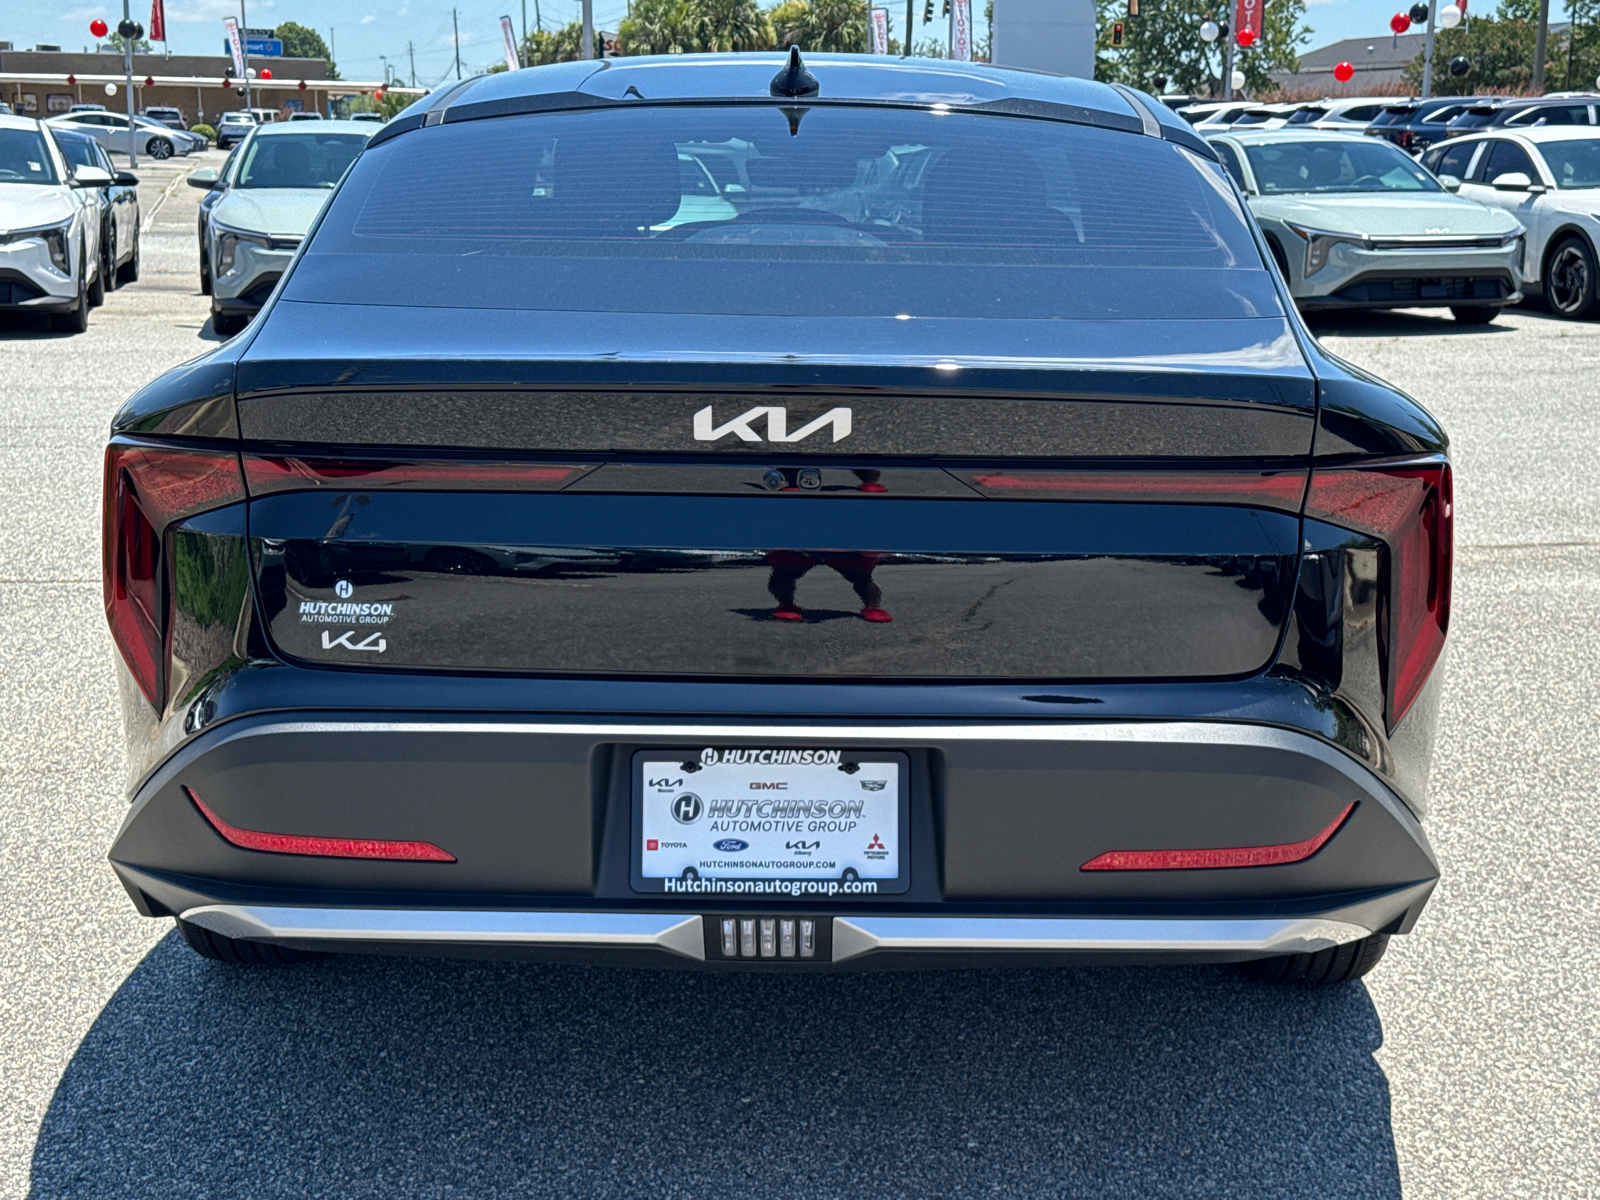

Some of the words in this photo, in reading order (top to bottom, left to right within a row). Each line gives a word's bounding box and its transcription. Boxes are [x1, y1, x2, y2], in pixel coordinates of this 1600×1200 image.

[694, 405, 852, 443] KIA
[299, 602, 393, 615] HUTCHINSON
[301, 615, 356, 623] AUTOMOTIVE
[359, 616, 389, 624] GROUP
[321, 630, 387, 653] K4
[722, 749, 841, 764] HUTCHINSON
[649, 778, 683, 787] KIA
[707, 800, 864, 819] HUTCHINSON
[710, 820, 804, 832] AUTOMOTIVE
[807, 820, 857, 832] GROUP
[719, 840, 743, 850] Ford
[785, 841, 820, 850] KIA
[700, 860, 836, 868] HUTCHINSONAUTOGROUP.COM
[664, 877, 877, 896] Hutchinsonautogroup.com
